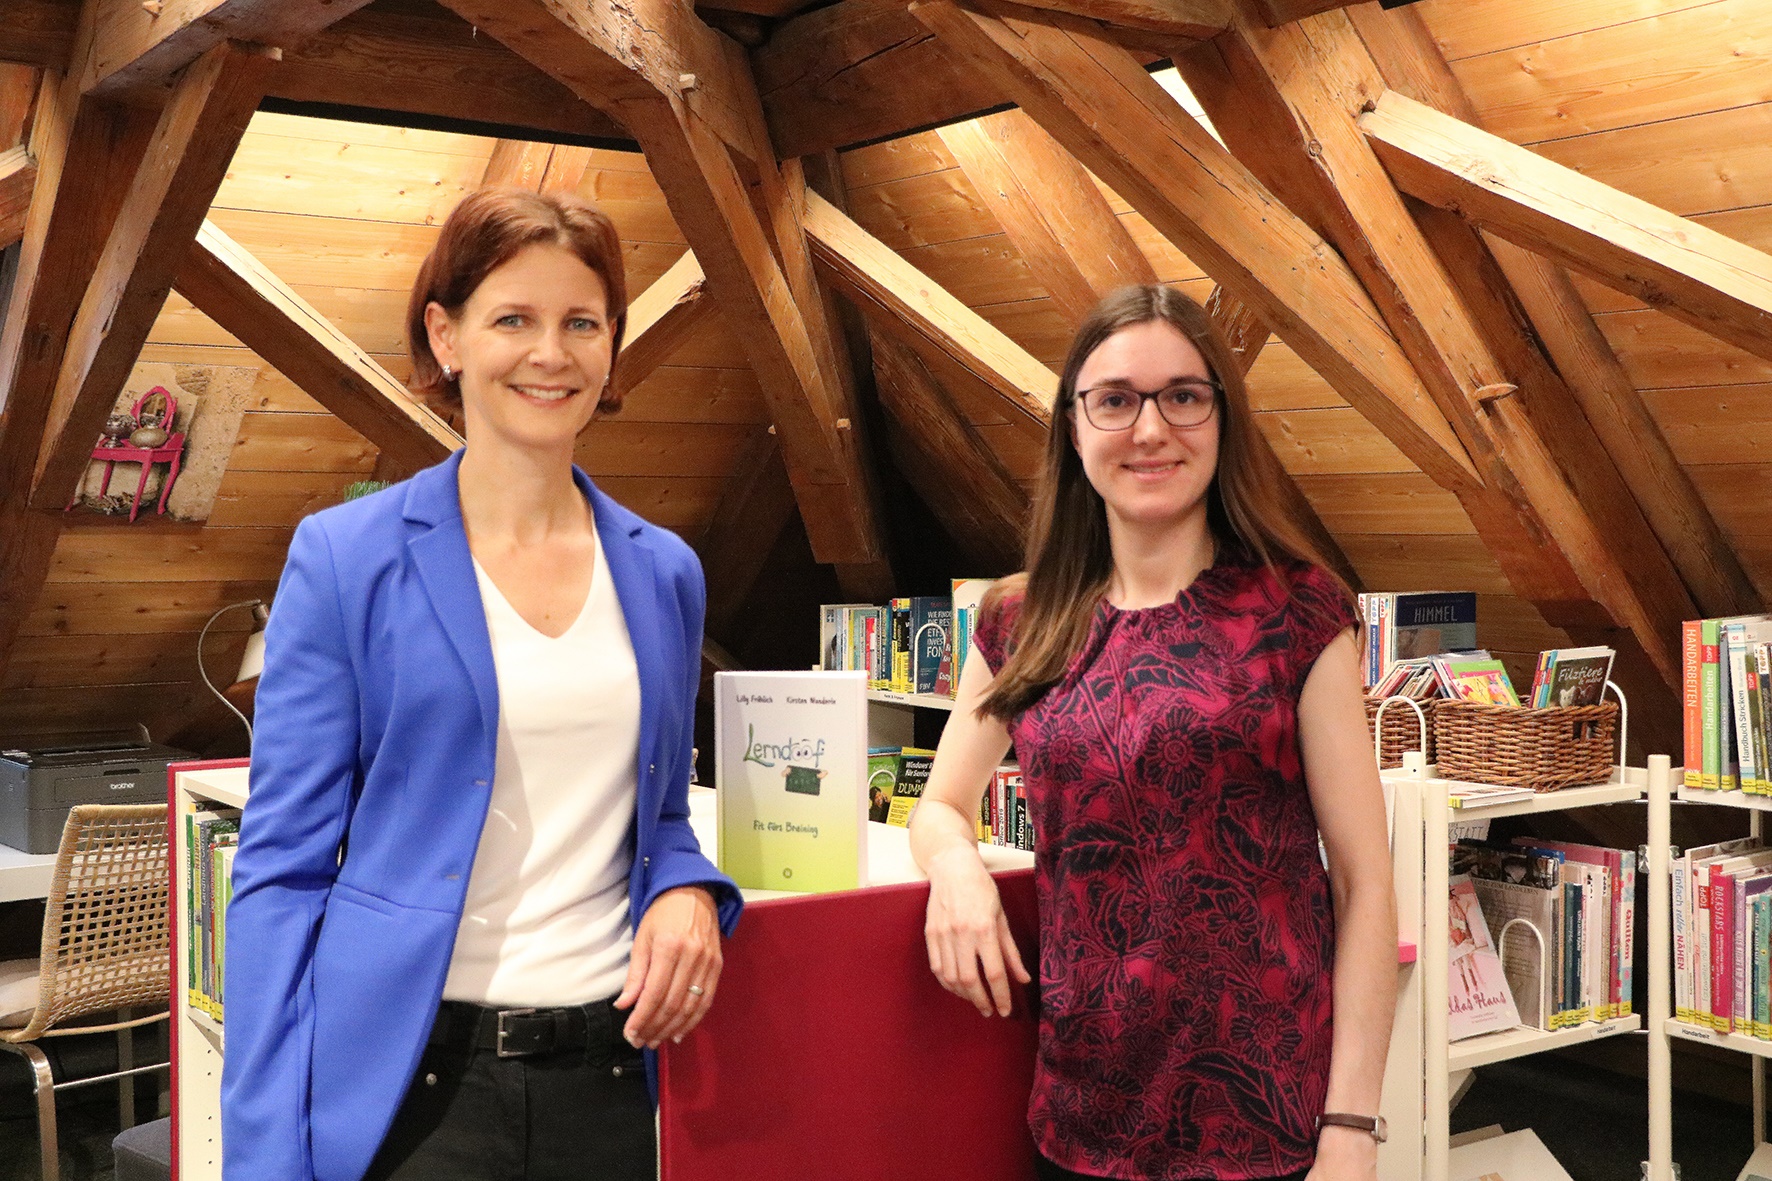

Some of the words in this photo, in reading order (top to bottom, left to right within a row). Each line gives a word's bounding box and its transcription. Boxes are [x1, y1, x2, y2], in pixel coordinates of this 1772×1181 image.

[1414, 606, 1458, 622] HIMMEL
[1686, 629, 1698, 708] HANDARBEITEN
[1759, 647, 1767, 672] TOPP
[1558, 666, 1603, 682] Filztiere
[736, 694, 749, 705] Lilly
[1705, 670, 1714, 730] Handarbeiten
[1738, 690, 1746, 722] Stricken
[1740, 723, 1750, 762] Handbuch
[110, 781, 135, 790] brother
[753, 820, 764, 831] Fit
[767, 821, 782, 832] fürs
[786, 821, 818, 838] Braining
[1675, 869, 1686, 906] Einfach
[1676, 909, 1686, 932] selber
[1715, 886, 1724, 930] ROCKSTARS
[1624, 909, 1632, 960] Quilten
[1677, 935, 1685, 970] NÄHEN
[1474, 992, 1506, 1009] Haus
[1682, 1028, 1710, 1039] Handarbeit
